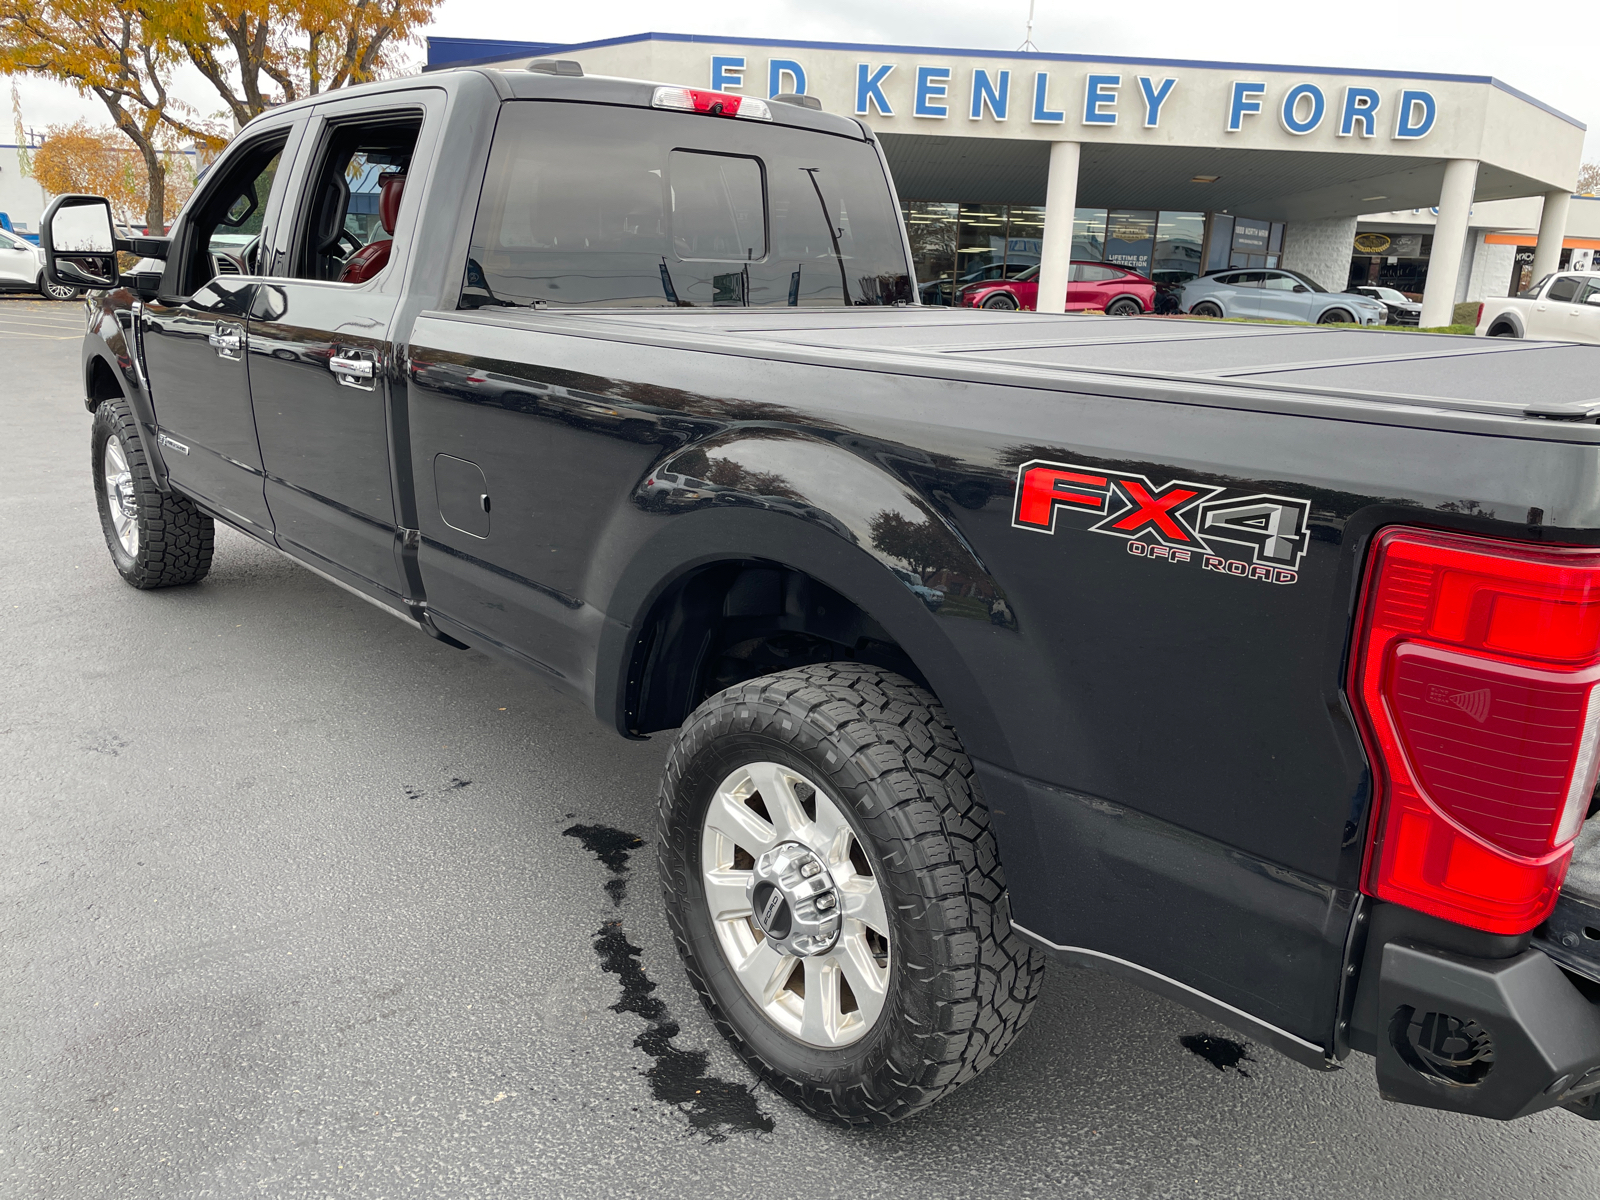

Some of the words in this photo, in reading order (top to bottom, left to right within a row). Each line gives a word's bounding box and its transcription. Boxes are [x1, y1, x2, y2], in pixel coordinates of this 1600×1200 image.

[710, 55, 808, 100] ED
[854, 62, 1180, 127] KENLEY
[1228, 80, 1439, 139] FORD
[1011, 458, 1312, 571] FX4
[1127, 540, 1192, 563] OFF
[1202, 555, 1299, 585] ROAD
[676, 750, 715, 823] TIRES
[672, 826, 692, 914] TOYO
[763, 895, 779, 926] FORD
